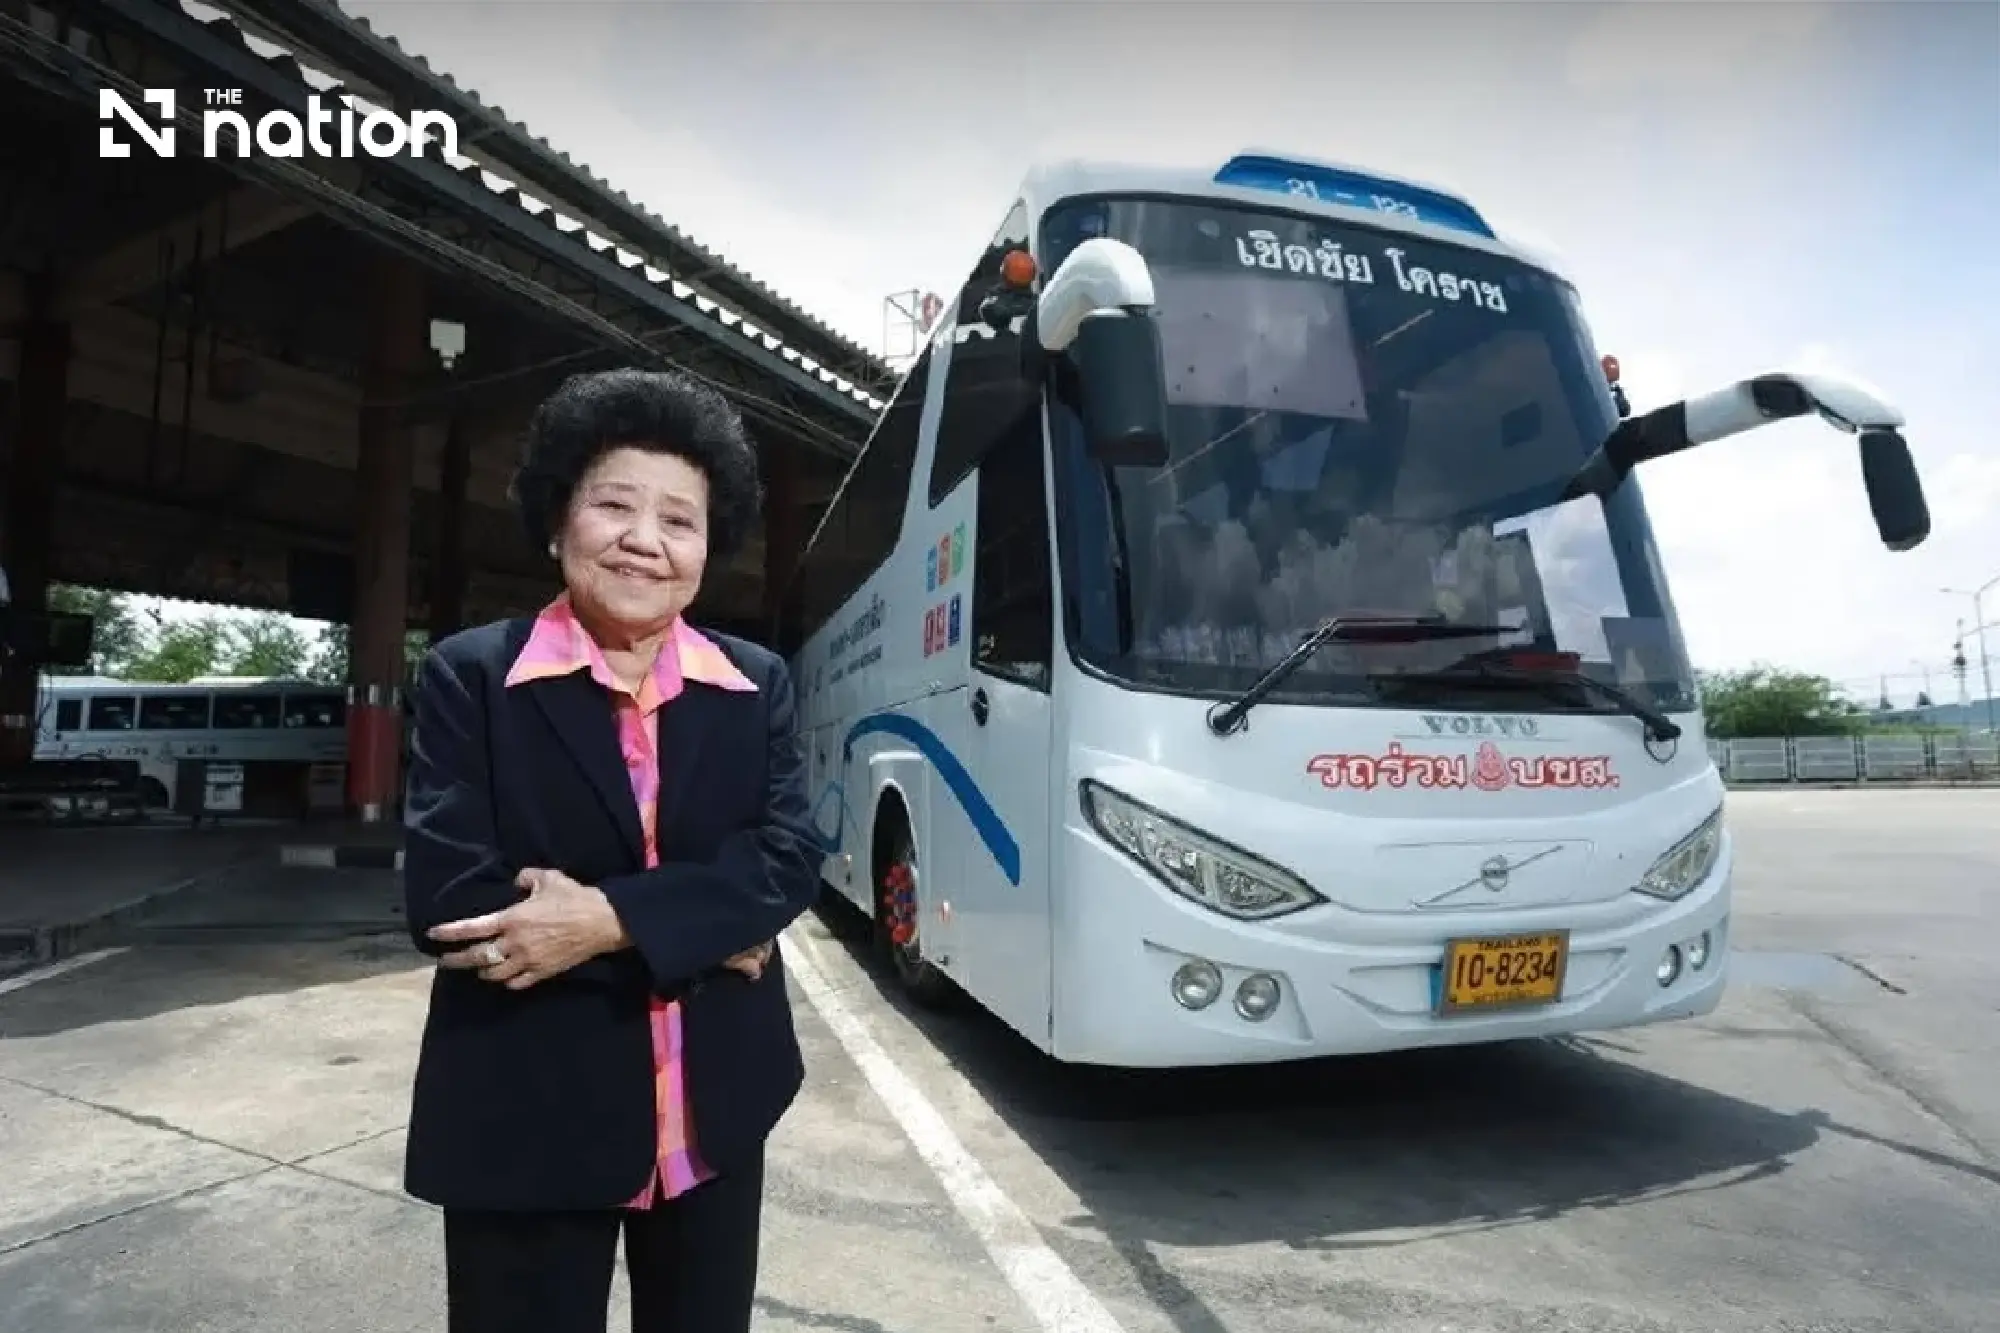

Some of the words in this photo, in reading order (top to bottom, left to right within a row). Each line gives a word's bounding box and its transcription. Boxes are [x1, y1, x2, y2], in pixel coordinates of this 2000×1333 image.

[1384, 247, 1508, 314] โคราช
[1421, 715, 1539, 736] VOLVO
[1306, 741, 1468, 790] รถร่วม
[1455, 950, 1558, 990] 10-8234
